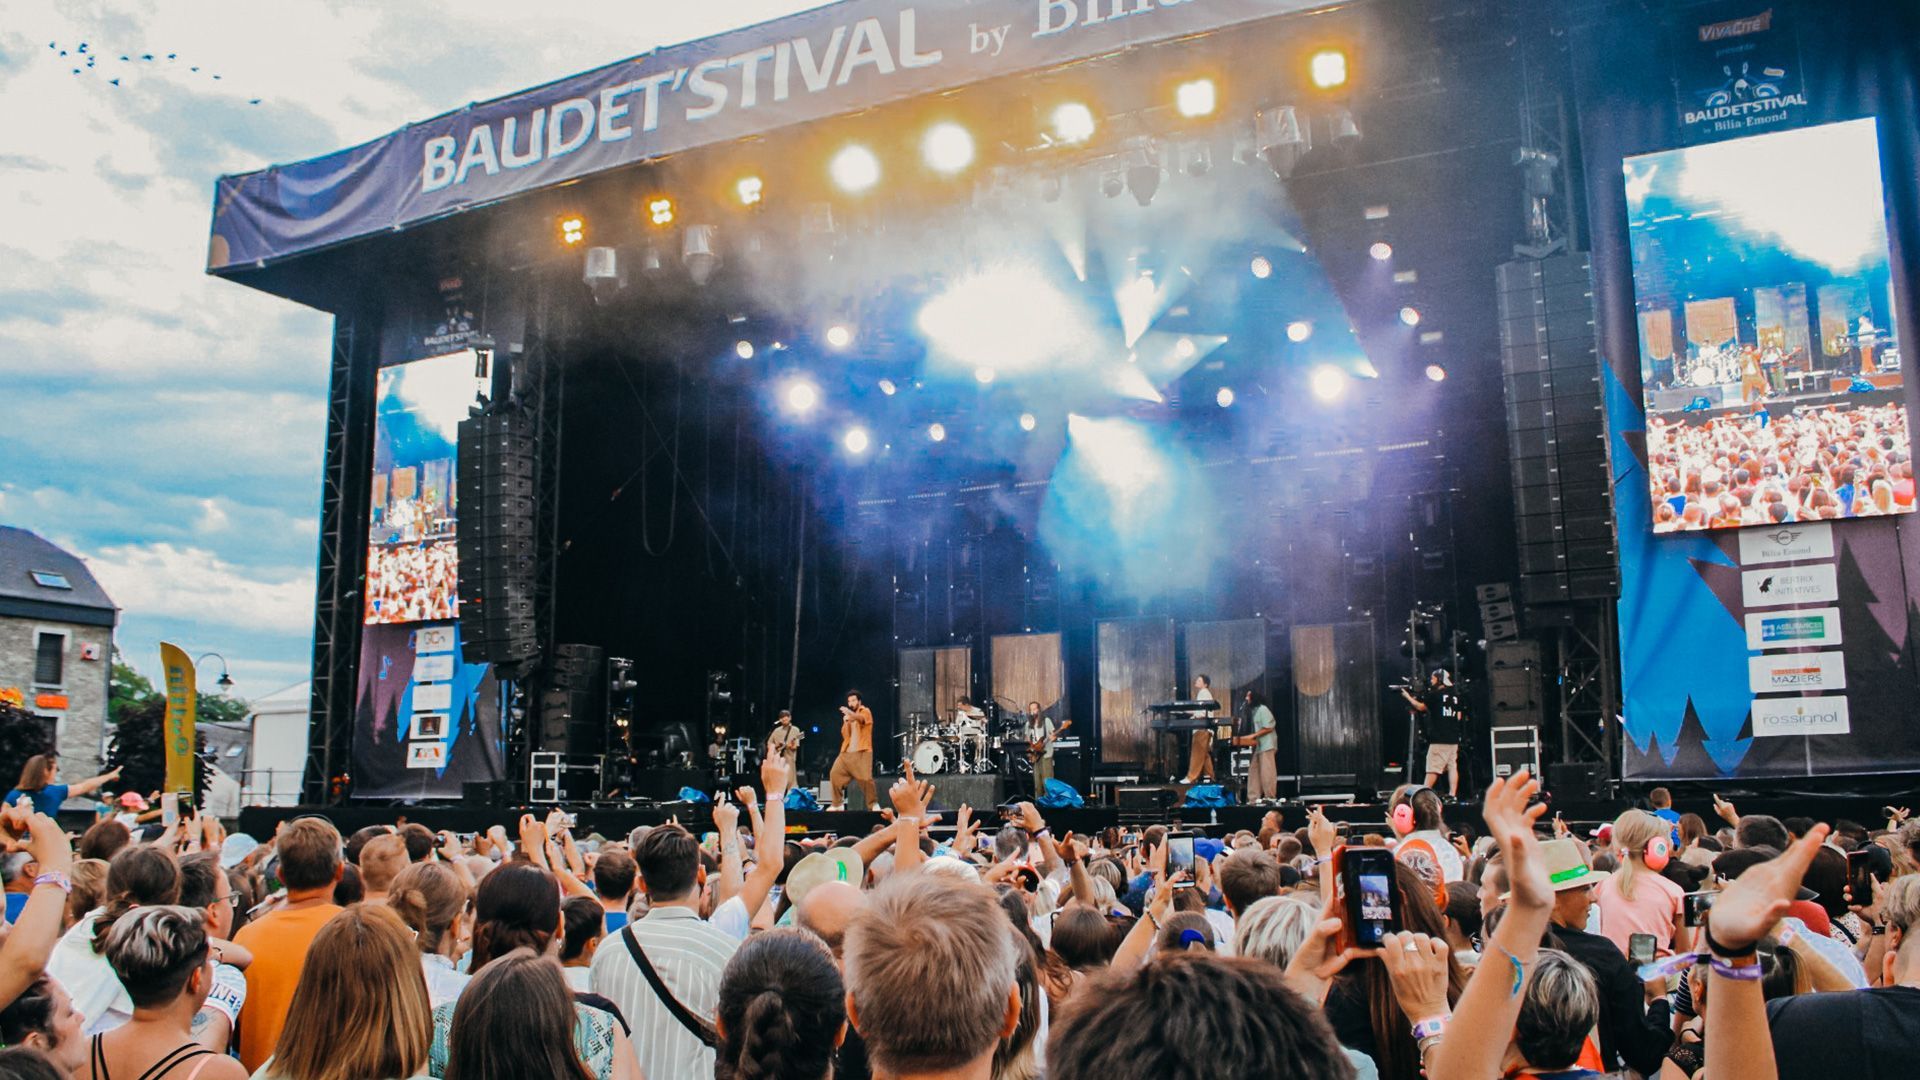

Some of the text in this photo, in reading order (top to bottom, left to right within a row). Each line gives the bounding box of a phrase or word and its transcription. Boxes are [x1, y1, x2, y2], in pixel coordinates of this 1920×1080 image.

[422, 8, 1012, 194] BAUDET'STIVAL by
[1771, 674, 1823, 684] MAZIERS
[1762, 711, 1838, 726] rossignol
